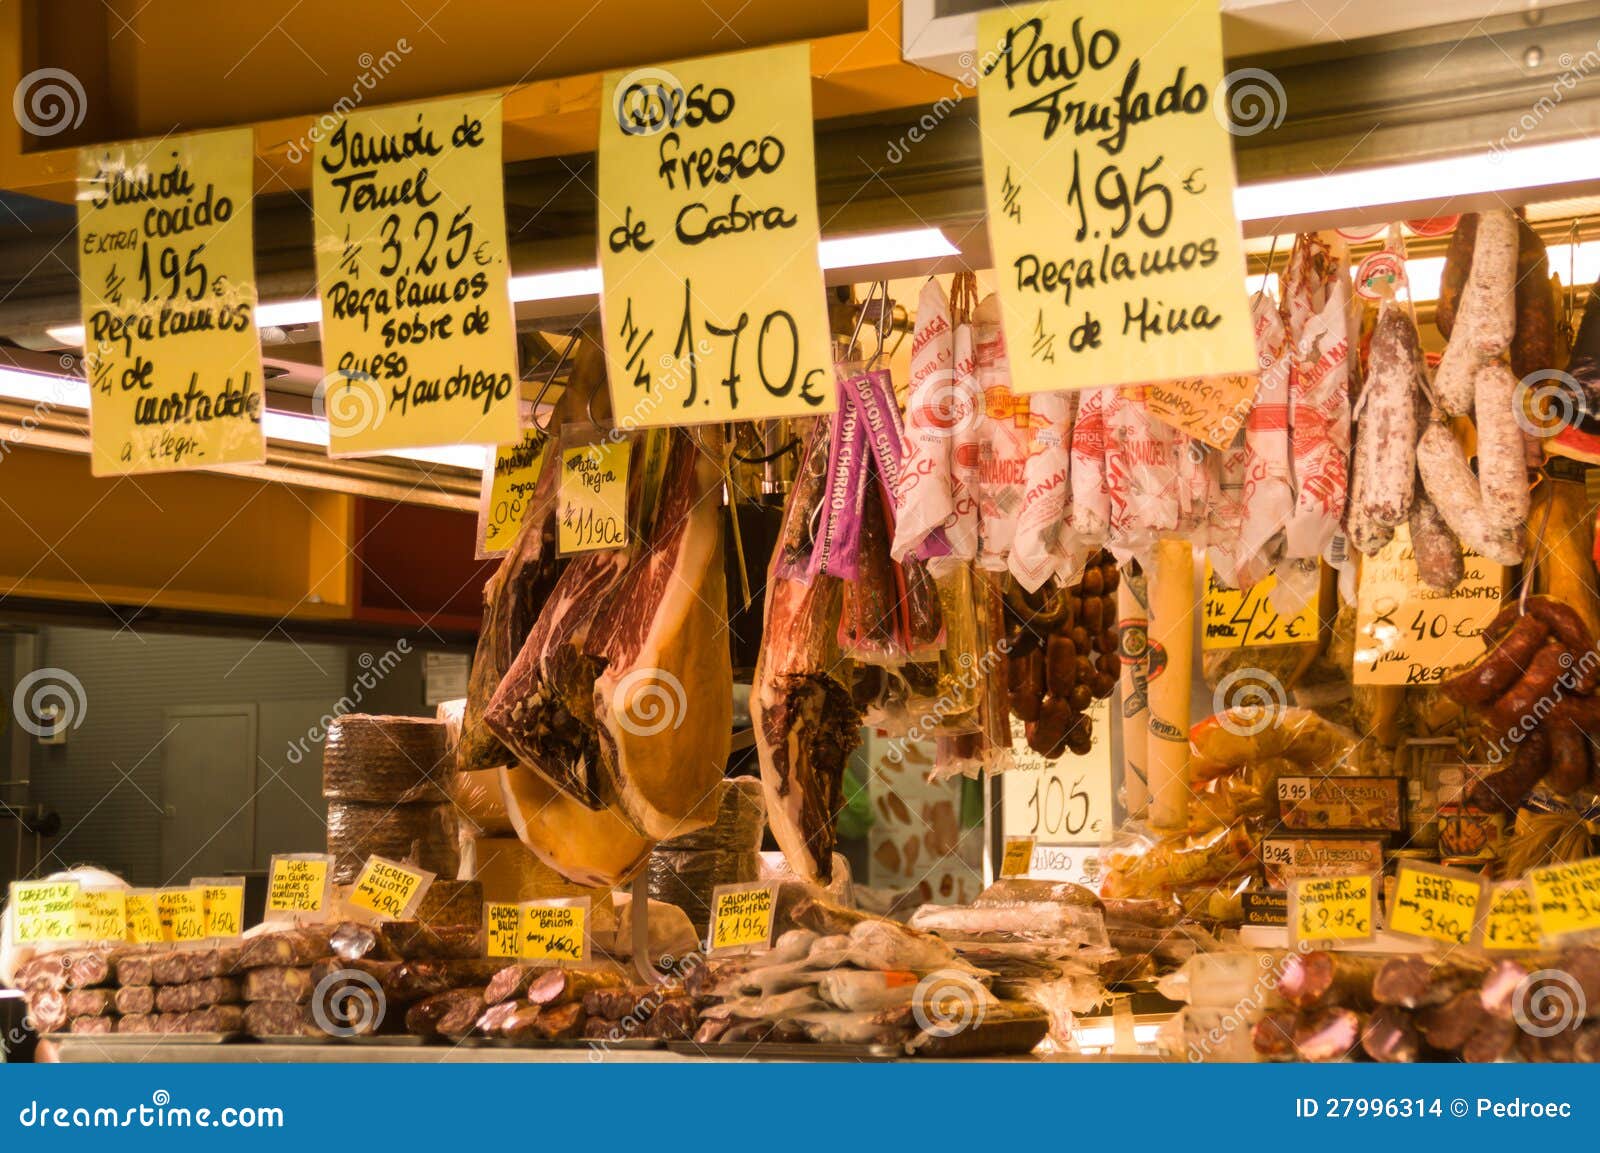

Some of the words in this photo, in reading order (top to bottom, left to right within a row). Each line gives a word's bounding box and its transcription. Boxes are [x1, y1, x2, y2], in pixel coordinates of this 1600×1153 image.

[1009, 57, 1209, 156] Trufado
[452, 115, 484, 148] de
[659, 131, 785, 191] fresco
[144, 184, 233, 238] cocido
[609, 205, 654, 253] de
[675, 194, 797, 246] Cabra
[83, 228, 138, 254] EXTRA
[1014, 236, 1220, 306] Regalamos
[327, 271, 488, 331] Regalamos
[90, 303, 250, 357] Regalamos
[381, 312, 453, 348] sobre
[463, 305, 489, 335] de
[1068, 311, 1102, 353] de
[121, 356, 153, 391] de
[831, 447, 852, 510] CHARRO
[369, 874, 409, 898] BELLOTA
[374, 863, 415, 886] SECRETO
[1416, 875, 1453, 890] LOMO
